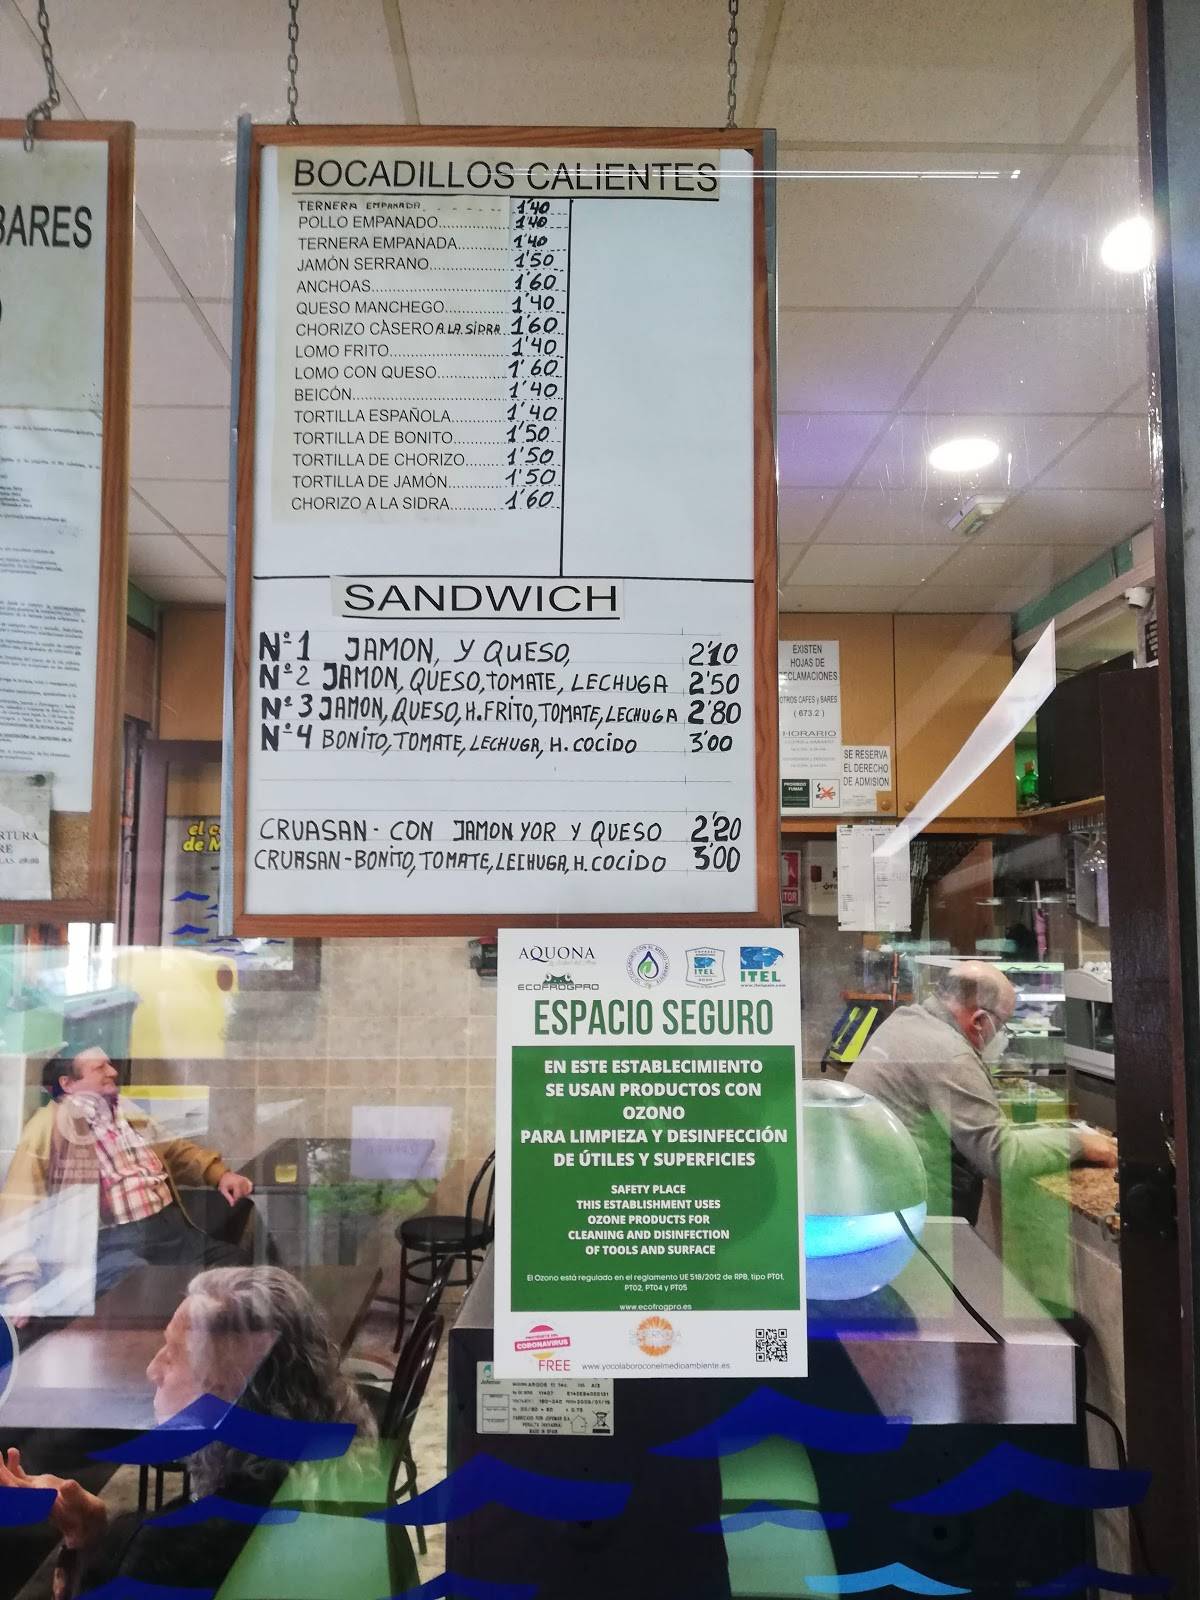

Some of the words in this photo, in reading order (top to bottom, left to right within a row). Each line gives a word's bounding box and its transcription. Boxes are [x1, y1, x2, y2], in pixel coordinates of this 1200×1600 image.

[294, 159, 514, 190] BOCADILLOS
[527, 162, 718, 192] CALIENTES
[298, 200, 357, 211] TERNERA
[366, 201, 421, 210] EMPANADA
[0, 205, 92, 248] ARES
[299, 216, 348, 229] POLLO
[353, 216, 438, 229] EMPANADO
[298, 237, 369, 250] TERNERA
[373, 236, 458, 250] EMPANADA
[297, 256, 349, 272] JAMÓN
[354, 257, 429, 270] SERRANO
[514, 251, 554, 268] 1'50
[297, 280, 371, 293] ANCHOAS
[515, 271, 557, 290] 1'60
[296, 301, 350, 315] QUESO
[355, 300, 445, 313] MANCHEGO
[512, 293, 555, 313] 1'40
[296, 322, 365, 336] CHORIZO
[511, 314, 558, 335] 1'60
[295, 345, 339, 358] LOMO
[344, 344, 389, 357] FRITO
[512, 336, 557, 356] 1'40
[295, 366, 338, 380] LOMO
[343, 366, 376, 379] CON
[381, 366, 437, 379] QUESO
[508, 359, 558, 378] 1'60
[294, 385, 352, 401] BEICÓN
[509, 380, 557, 398] 1'40
[294, 410, 365, 423] TORTILLA
[369, 407, 451, 422] ESPAÑOLA
[507, 402, 557, 421] 1'40
[294, 432, 365, 445] TORTILLA
[369, 431, 389, 444] DE
[394, 431, 453, 444] BONITO
[506, 421, 550, 443] 1'50
[293, 454, 365, 467] TORTILLA
[369, 453, 389, 466] DE
[394, 453, 465, 466] CHORIZO
[507, 447, 554, 466] 1'50
[292, 475, 364, 488] TORTILLA
[368, 475, 388, 488] DE
[393, 473, 447, 488] JAMÓN
[505, 469, 555, 486] 1'50
[291, 497, 361, 511] CHORIZO
[366, 497, 376, 510] A
[380, 497, 399, 510] LA
[403, 497, 450, 510] SIDRA
[505, 489, 554, 510] 1'60
[345, 584, 616, 611] SANDWICH
[345, 637, 439, 667] JAMON,
[793, 645, 823, 654] EXISTEN
[791, 658, 813, 667] HOJAS
[815, 658, 825, 667] DE
[571, 674, 668, 694] LECHUGA
[779, 672, 838, 681] ECLAMACIONES
[821, 696, 838, 704] BARES
[606, 705, 678, 723] LECHUGA
[844, 750, 853, 759] SE
[856, 750, 888, 759] RESERVA
[844, 764, 852, 773] EL
[854, 764, 889, 773] DERECHO
[844, 777, 853, 786] DE
[855, 777, 890, 787] ADMISION
[188, 820, 205, 836] el
[390, 821, 433, 842] CON
[453, 820, 514, 842] JAMON
[591, 820, 662, 848] QUESO
[183, 836, 205, 852] de
[519, 946, 595, 962] AQUONA
[741, 971, 781, 982] ITEL
[535, 999, 653, 1035] ESPACIO
[662, 999, 773, 1035] SEGURO
[544, 1060, 566, 1074] EN
[571, 1060, 607, 1074] ESTE
[612, 1060, 763, 1074] ESTABLECIMIENTO
[546, 1083, 564, 1097] SE
[569, 1083, 615, 1097] USAN
[620, 1083, 721, 1097] PRODUCTOS
[725, 1083, 762, 1097] CON
[623, 1106, 685, 1120] OZONO
[521, 1130, 566, 1143] PARA
[570, 1130, 648, 1143] LIMPIEZA
[652, 1130, 662, 1143] Y
[667, 1126, 788, 1143] DESINFECCIÓN
[554, 1153, 575, 1167] DE
[580, 1150, 635, 1167] ÚTILES
[639, 1153, 649, 1167] Y
[654, 1153, 756, 1167] SUPERFICIES
[611, 1185, 650, 1194] SAFETY
[653, 1185, 686, 1194] PLACE
[577, 1200, 601, 1210] THIS
[604, 1200, 692, 1210] ESTABLISHMENT
[695, 1200, 721, 1210] USES
[587, 1215, 627, 1225] OZONE
[629, 1215, 686, 1225] PRODUCTS
[689, 1215, 710, 1225] FOR
[568, 1230, 625, 1240] CLEANING
[627, 1230, 651, 1240] AND
[654, 1230, 730, 1240] DISINFECTION
[585, 1246, 601, 1255] OF
[603, 1246, 639, 1255] TOOLS
[641, 1246, 665, 1255] AND
[668, 1246, 716, 1255] SURFACE
[578, 1274, 613, 1283] regulado
[634, 1274, 678, 1283] reglamento
[751, 1274, 766, 1282] tipo
[620, 1303, 693, 1311] www.ecofrogpro.es
[516, 1338, 569, 1350] CORONAVIRUS
[539, 1360, 571, 1371] FREE
